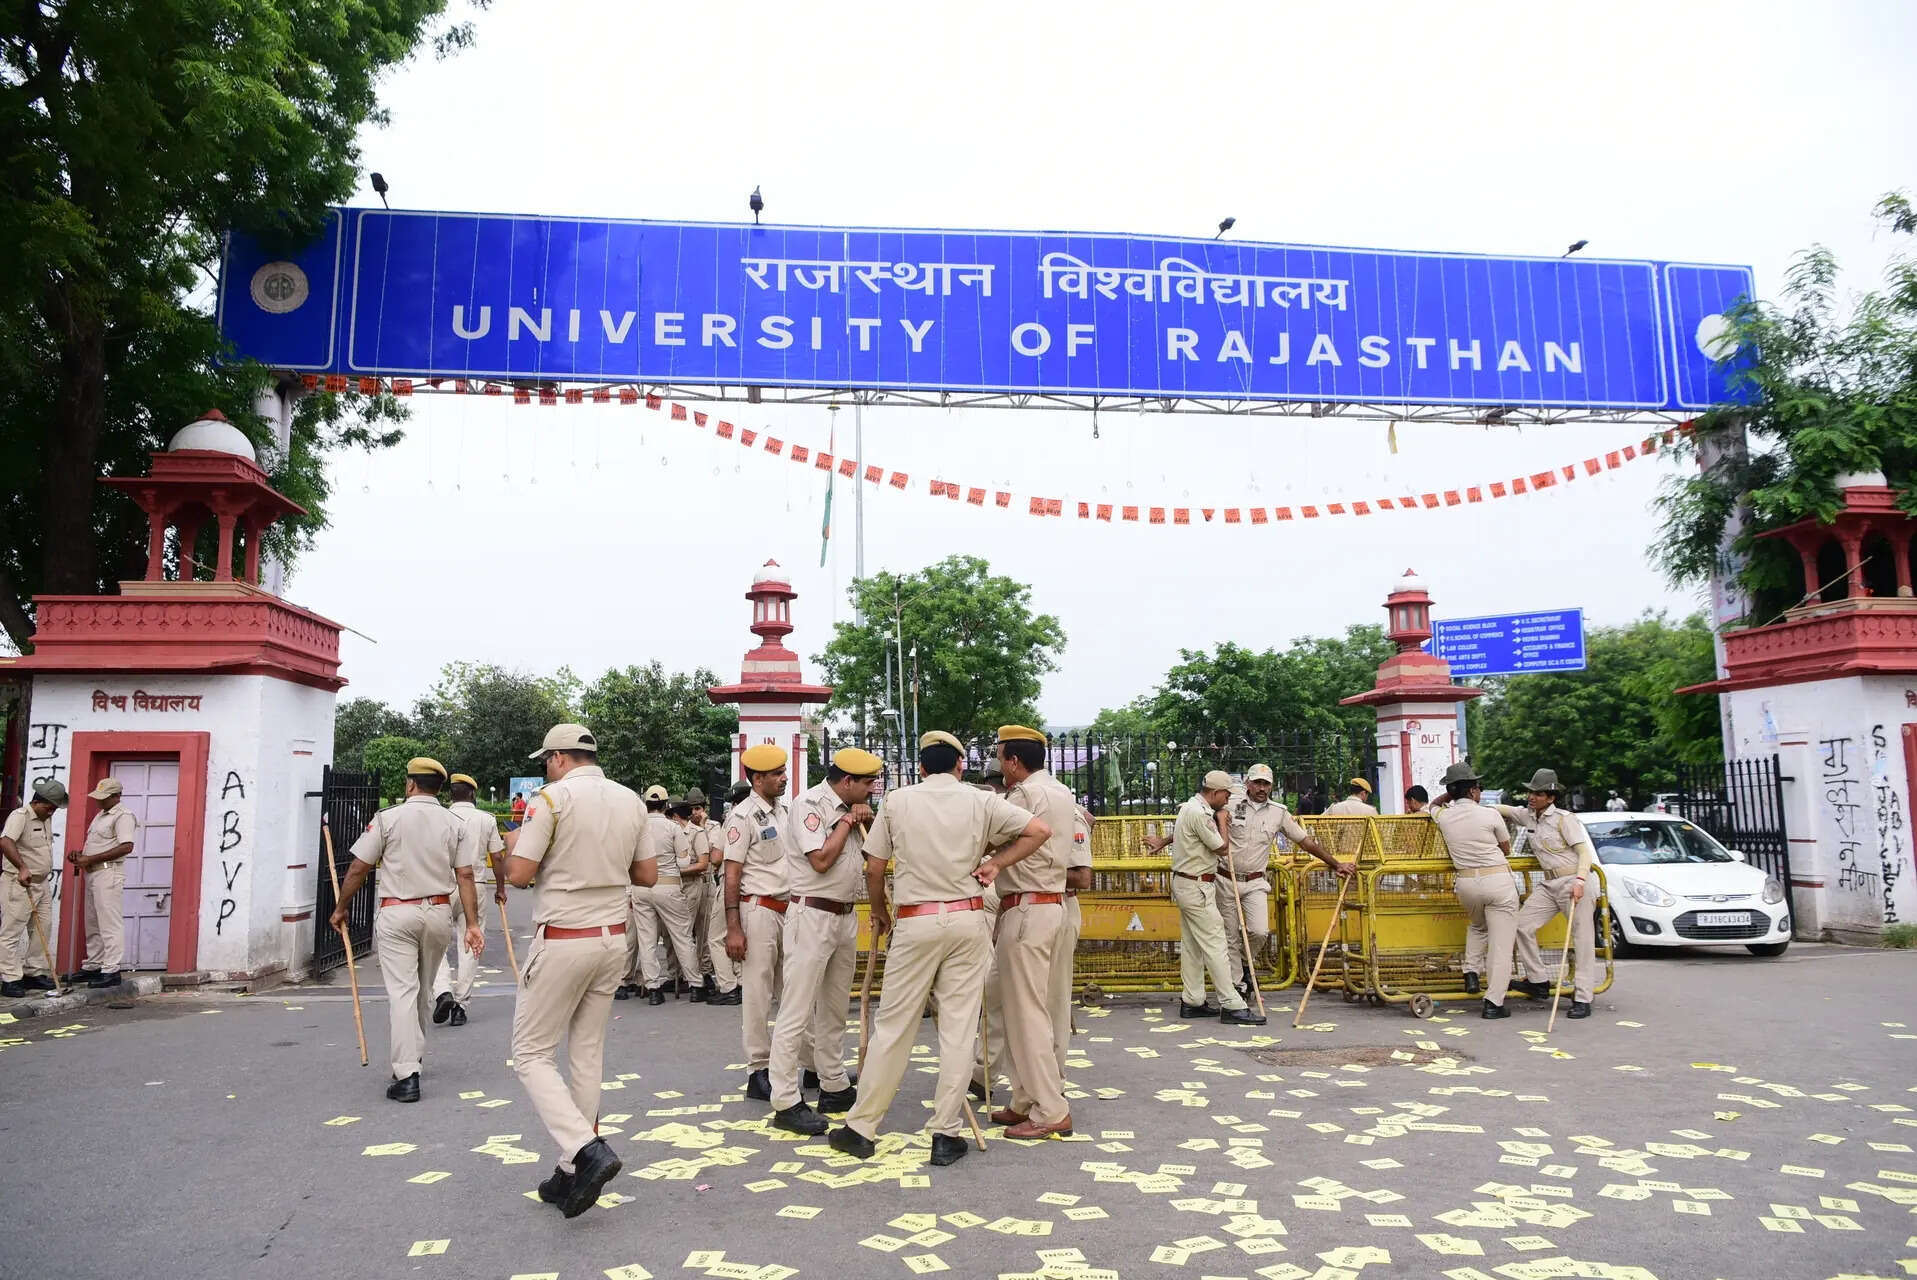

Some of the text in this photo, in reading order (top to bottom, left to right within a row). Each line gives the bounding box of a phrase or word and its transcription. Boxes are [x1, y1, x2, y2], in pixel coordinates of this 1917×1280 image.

[740, 252, 1350, 312] राजस्थान विश्वविद्यालय
[451, 303, 1583, 375] UNIVERSITY OF RAJASTHAN
[92, 690, 203, 712] विश्व विद्यालय
[763, 737, 776, 746] IN
[1421, 733, 1440, 744] OUT
